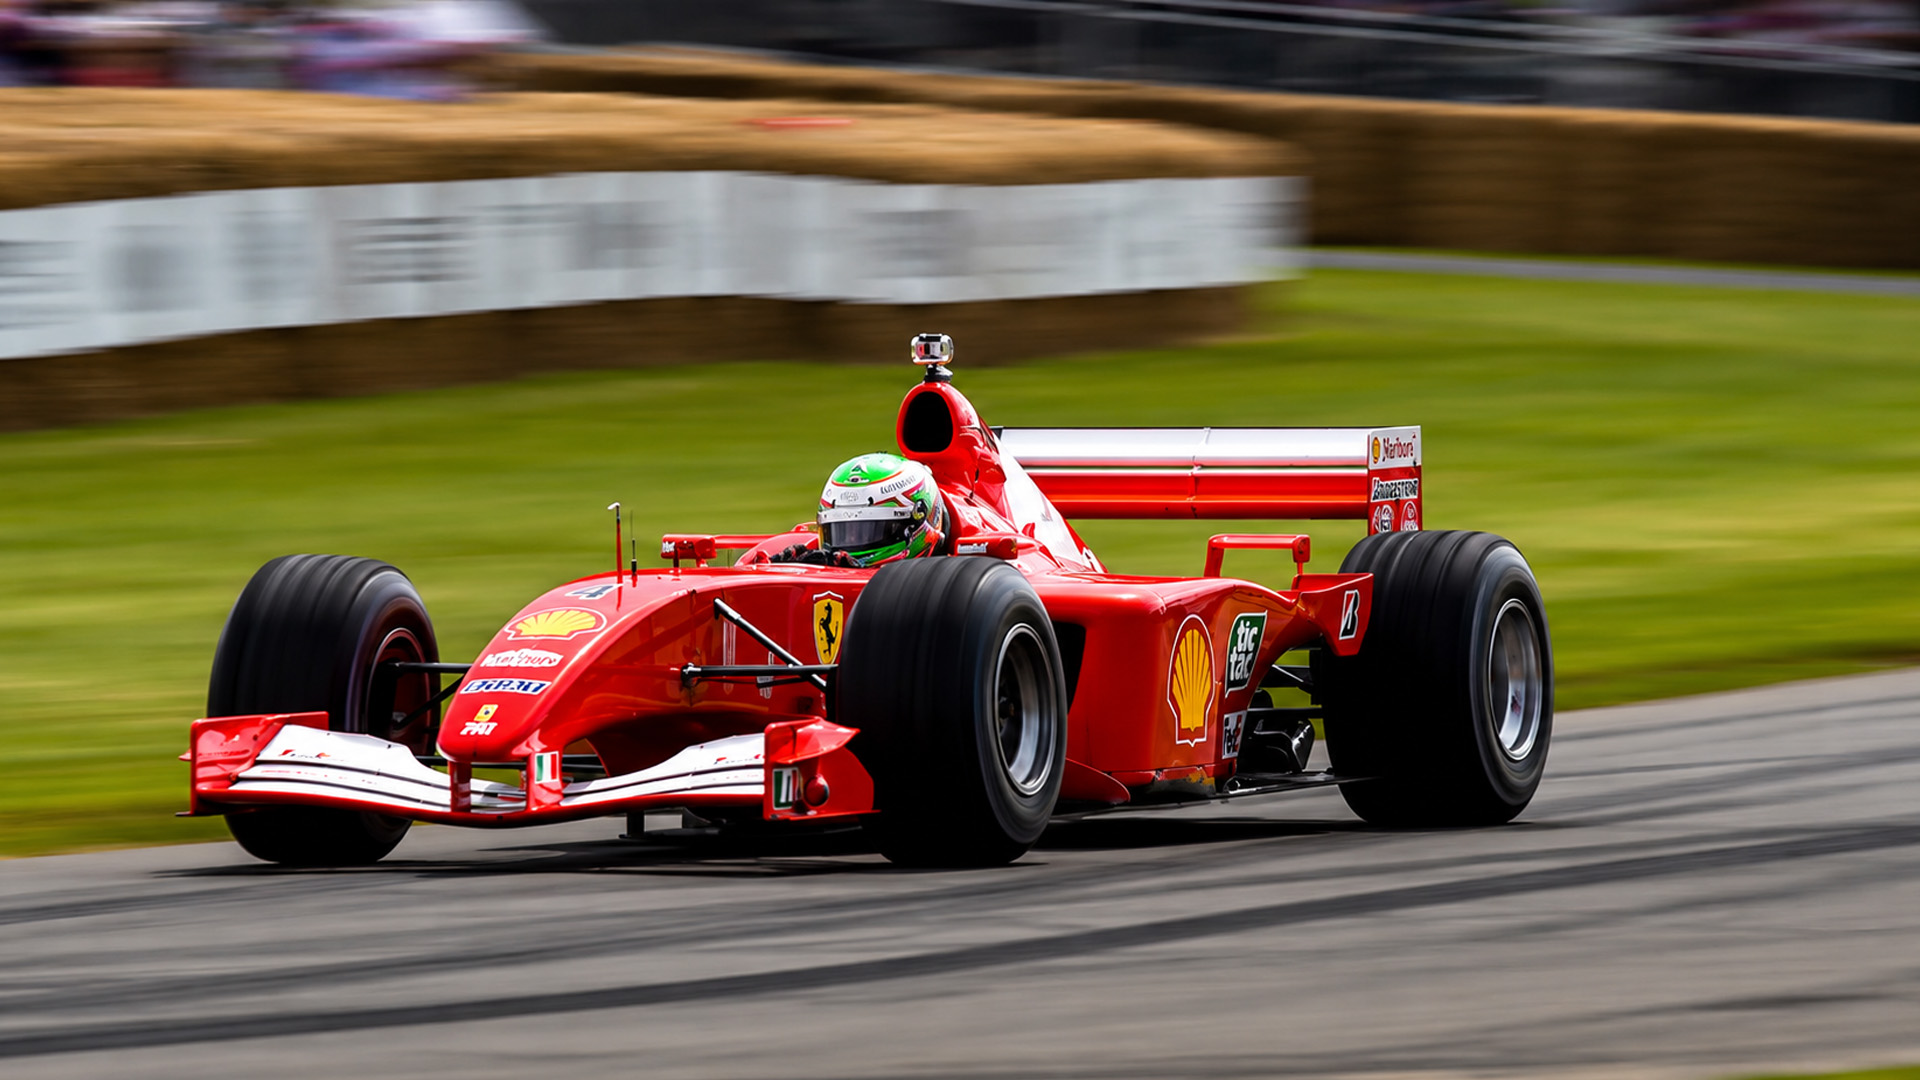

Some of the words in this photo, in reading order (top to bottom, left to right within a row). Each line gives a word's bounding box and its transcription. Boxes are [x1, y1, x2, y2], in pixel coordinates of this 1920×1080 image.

[568, 584, 617, 598] 4
[1237, 619, 1259, 652] tic
[1229, 646, 1254, 681] tac
